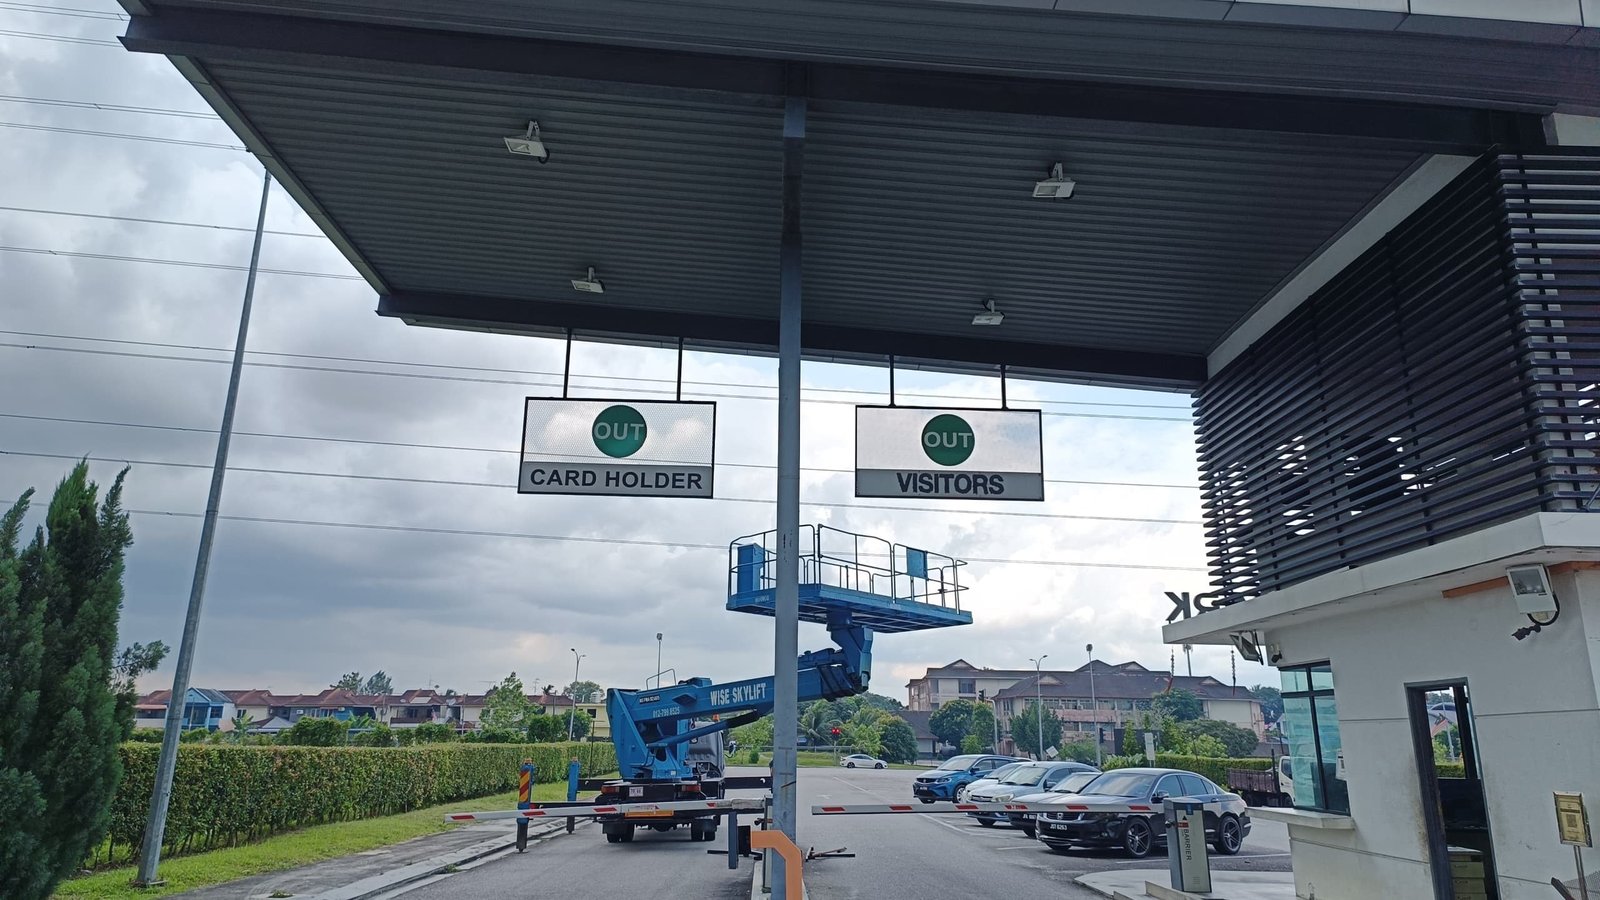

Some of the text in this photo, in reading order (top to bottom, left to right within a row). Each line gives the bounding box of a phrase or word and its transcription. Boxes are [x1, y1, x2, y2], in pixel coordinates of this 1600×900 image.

[594, 422, 644, 441] OUT
[923, 431, 972, 448] OUT
[530, 469, 702, 490] CARD HOLDER
[896, 472, 1005, 495] VISITORS
[710, 682, 767, 706] WISE SKYLIFT
[1183, 828, 1192, 861] BARRIER
